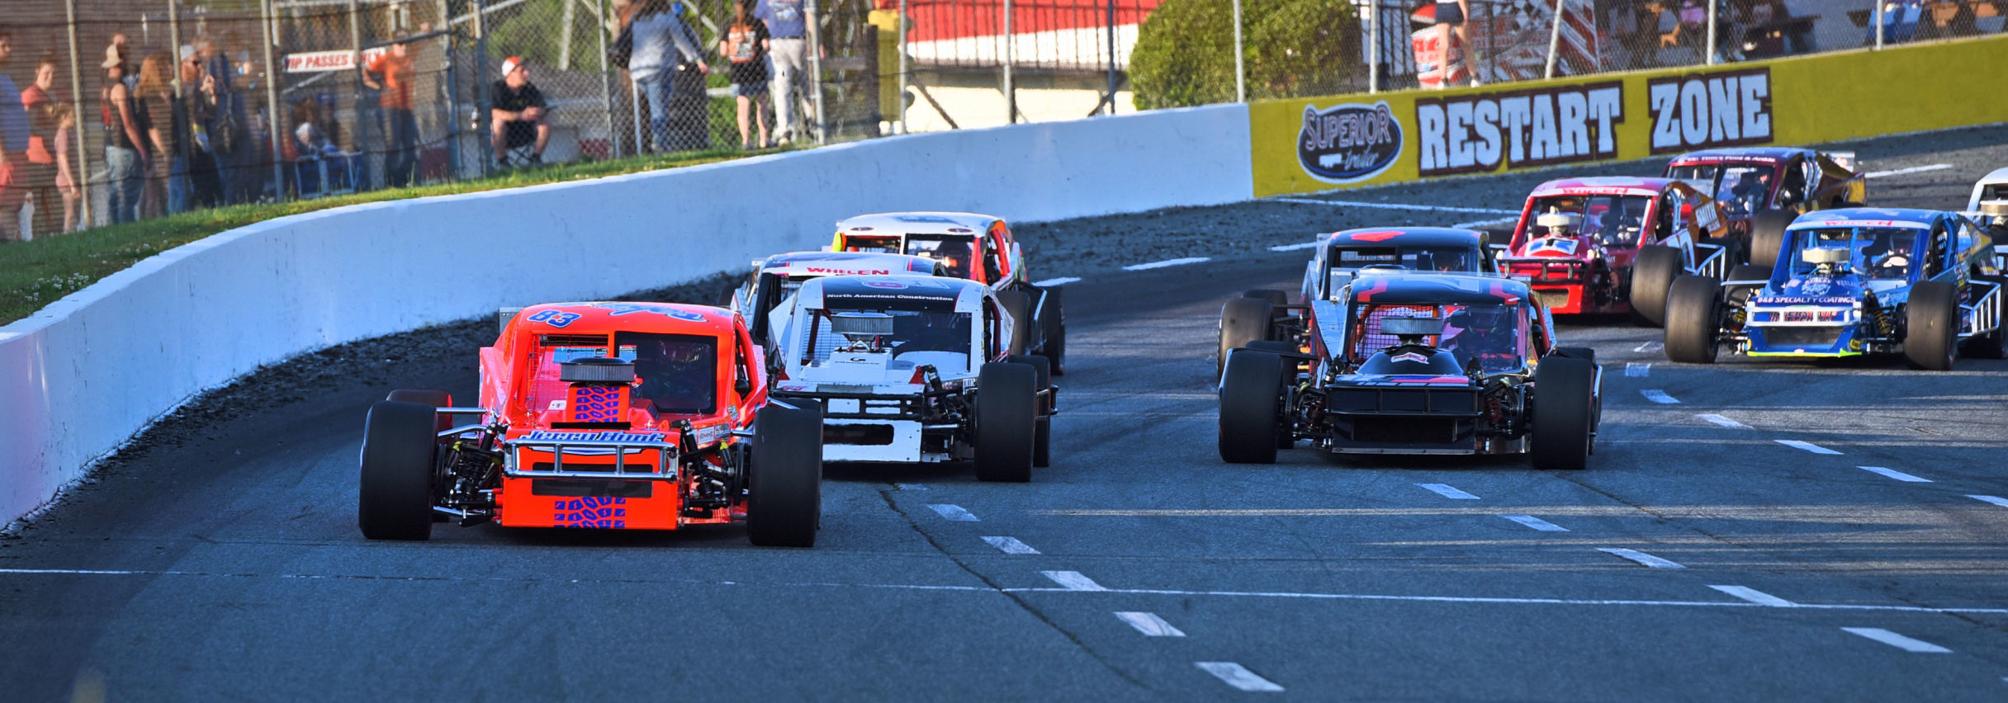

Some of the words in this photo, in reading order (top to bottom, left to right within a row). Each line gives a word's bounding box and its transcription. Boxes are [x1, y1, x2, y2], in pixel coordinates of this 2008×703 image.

[306, 54, 348, 68] PASSES
[1305, 106, 1392, 152] SUPERIOR
[1417, 88, 1621, 171] RESTART
[1651, 73, 1770, 149] ZONE
[807, 267, 889, 275] WHELEN
[527, 310, 583, 328] 83
